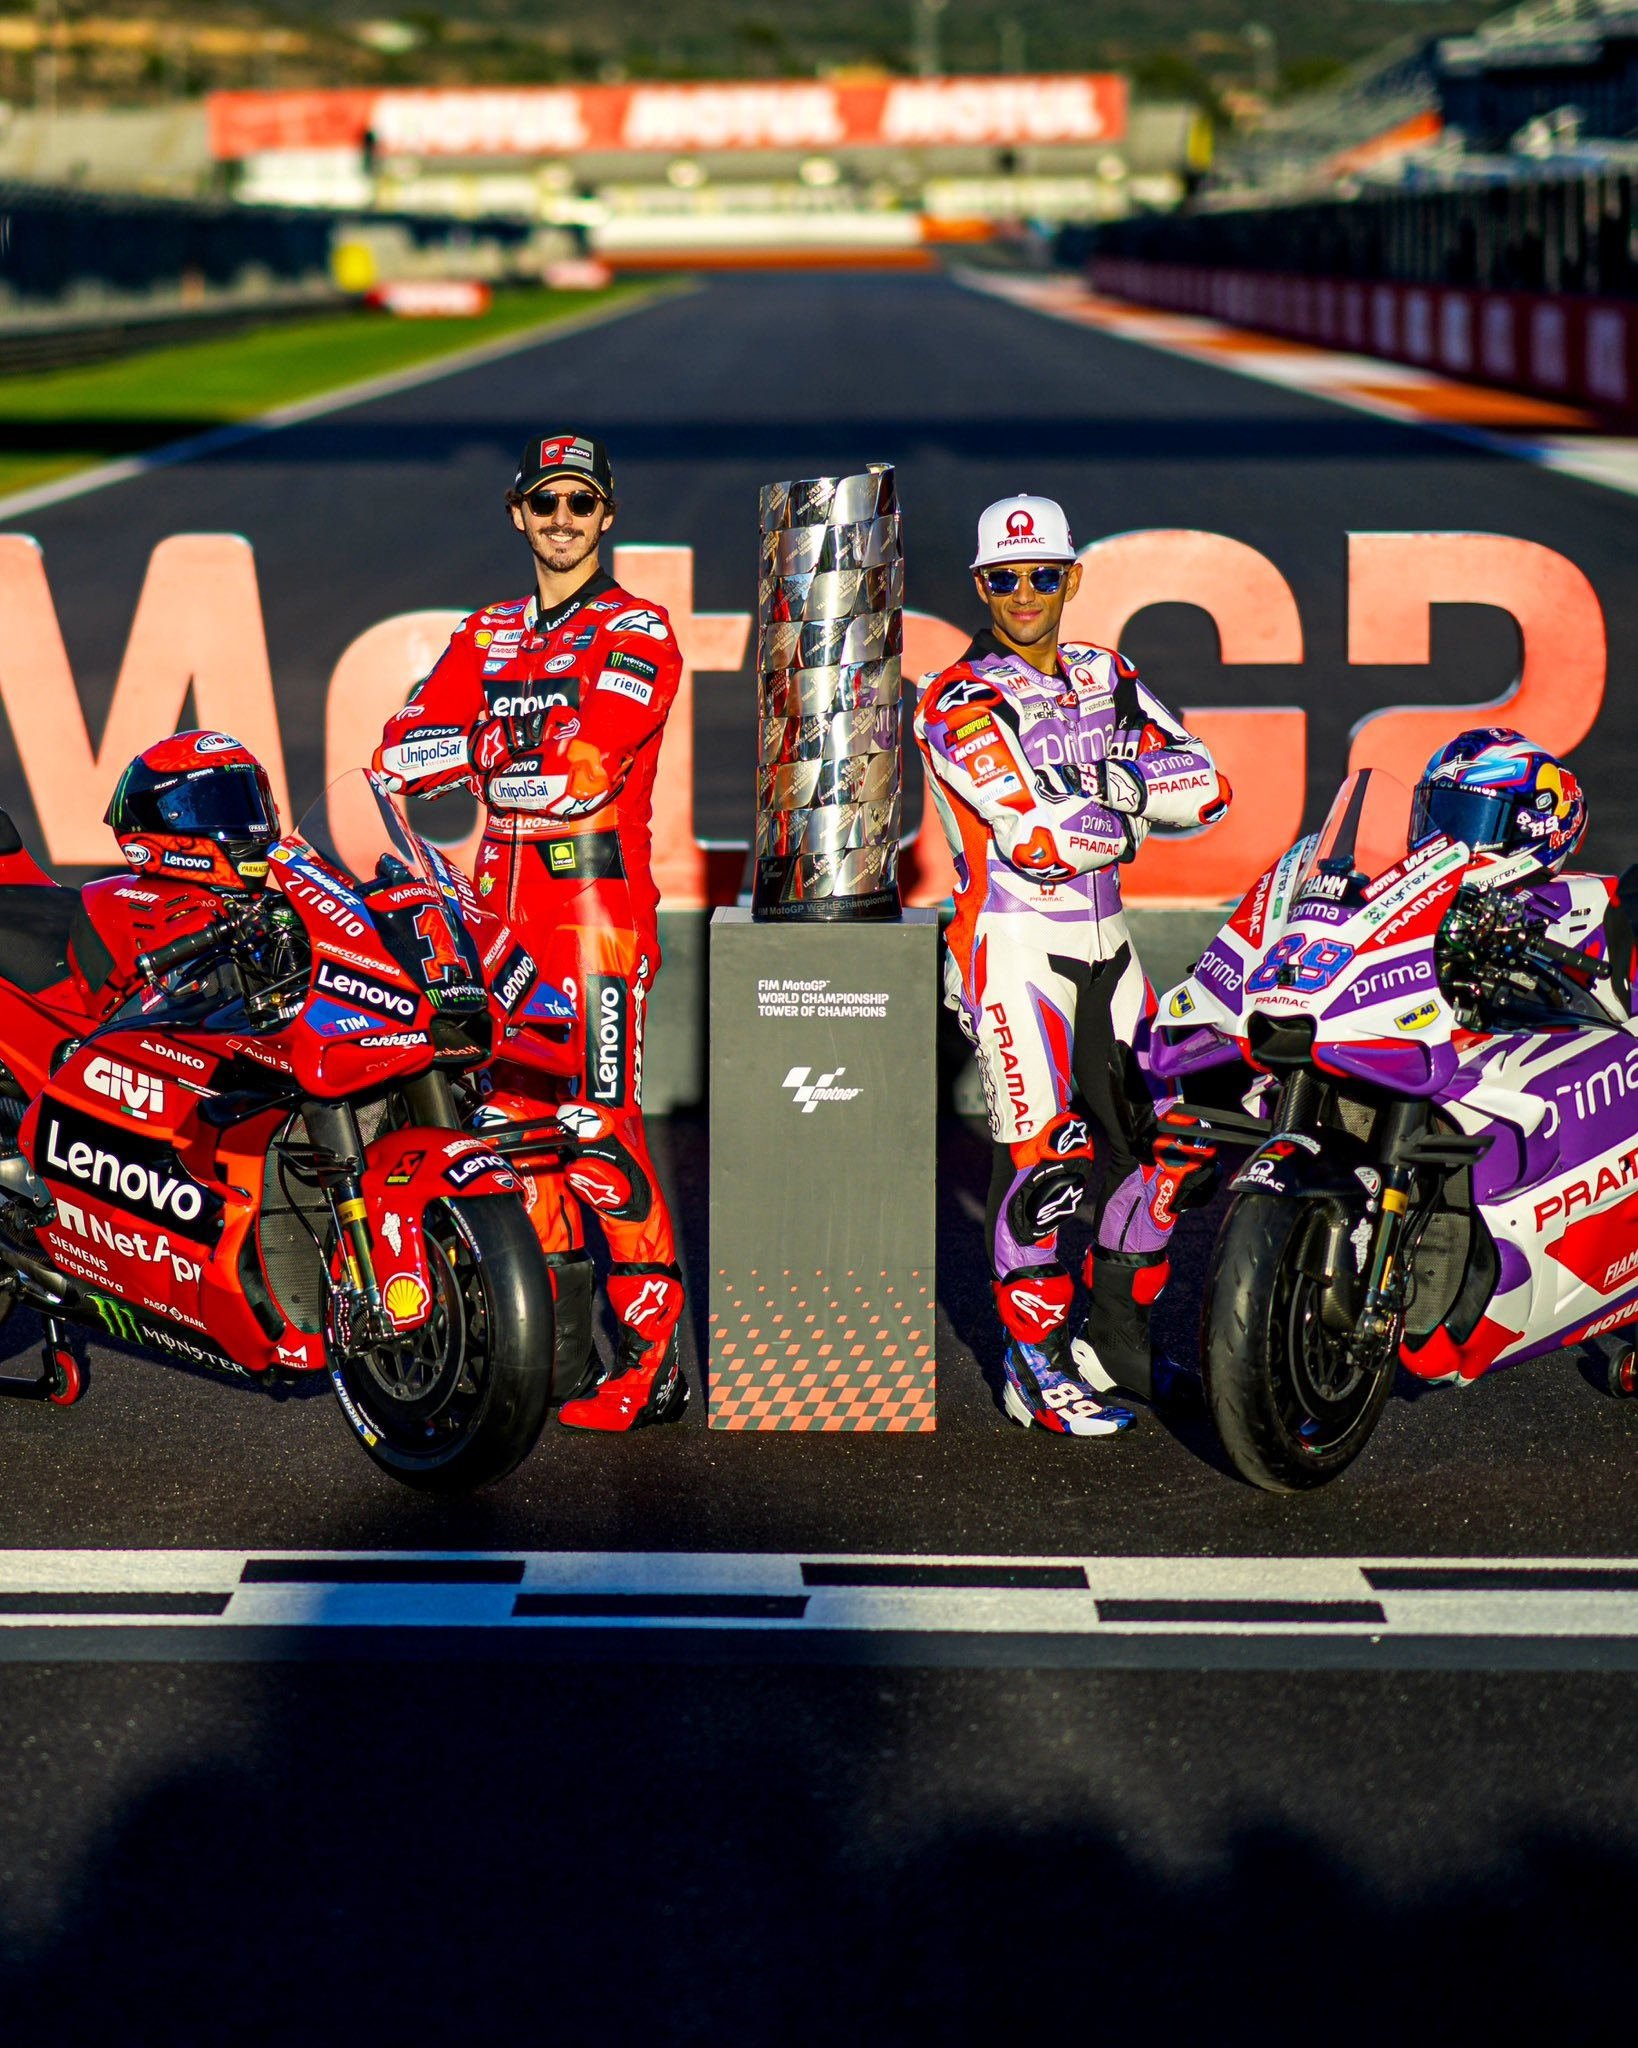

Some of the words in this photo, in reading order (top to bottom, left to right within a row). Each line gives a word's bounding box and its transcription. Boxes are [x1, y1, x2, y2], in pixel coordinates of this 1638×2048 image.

[565, 446, 590, 458] Lenovo
[997, 536, 1046, 548] PRAMAC
[546, 602, 580, 631] Lenovo
[483, 660, 502, 672] SAP
[623, 656, 654, 674] MONSTER
[1014, 662, 1041, 683] wallife
[613, 678, 648, 698] riello
[485, 691, 568, 717] Lenovo
[405, 727, 459, 740] Lenovo
[400, 740, 462, 766] UnipolSai
[953, 731, 999, 762] MOTUL
[505, 760, 539, 774] novo
[972, 765, 1008, 787] PRAMAC
[1148, 754, 1194, 777] prima
[494, 779, 549, 803] UnipolSai
[1148, 775, 1211, 795] PRAMAC
[488, 814, 570, 831] FRECCAROSSA
[126, 849, 147, 860] OMY
[1069, 836, 1120, 856] PRAMAC
[1402, 837, 1449, 873] WAS
[164, 852, 211, 869] Lenovo
[294, 863, 361, 907] ADVANCE
[1303, 874, 1349, 897] FIAMM
[1365, 868, 1402, 899] MOTUL
[1380, 870, 1431, 908] kyrrex
[1478, 866, 1518, 892] kyrrex
[114, 887, 161, 903] DUCATI
[1249, 871, 1273, 938] PRAMAC
[298, 886, 365, 938] riello
[769, 904, 804, 915] MotoGP
[1290, 903, 1340, 921] prima
[1374, 879, 1454, 945] PRAMAC
[413, 904, 473, 984] 1
[483, 926, 511, 968] FRECCIAROSSA
[316, 941, 401, 977] FRECCIAROSSA
[1245, 932, 1356, 995] 89
[493, 956, 534, 1011] Lenovo
[1196, 951, 1244, 992] prima
[1348, 959, 1432, 1004] prima
[317, 964, 415, 1016] Lenovo
[440, 985, 488, 998] MONSTER
[758, 979, 780, 991] FIM
[545, 1000, 575, 1017] TIM
[758, 992, 800, 1004] WORLD
[801, 993, 889, 1005] CHAMPIONSHIP
[1254, 996, 1311, 1009] PRAMAC
[758, 1005, 799, 1017] TOWER
[800, 1006, 815, 1017] OF
[817, 1006, 887, 1018] CHAMPIONS
[1400, 1003, 1435, 1027] WD-40
[336, 1015, 370, 1033] TIM
[360, 1032, 428, 1048] CARRERA
[595, 987, 620, 1098] Lenovo
[156, 1042, 205, 1070] DAIKO
[244, 1046, 277, 1066] Audi
[985, 1002, 1034, 1136] PRAMAC
[83, 1056, 164, 1114] GIVI
[47, 1119, 202, 1221] Lenovo
[49, 1231, 109, 1273] SIEMENS
[54, 1251, 125, 1294] streparava
[143, 1296, 168, 1314] PAGO
[141, 1323, 251, 1378] MONSTER
[333, 1381, 365, 1430] MICHELIN
[1041, 1382, 1103, 1422] 89
